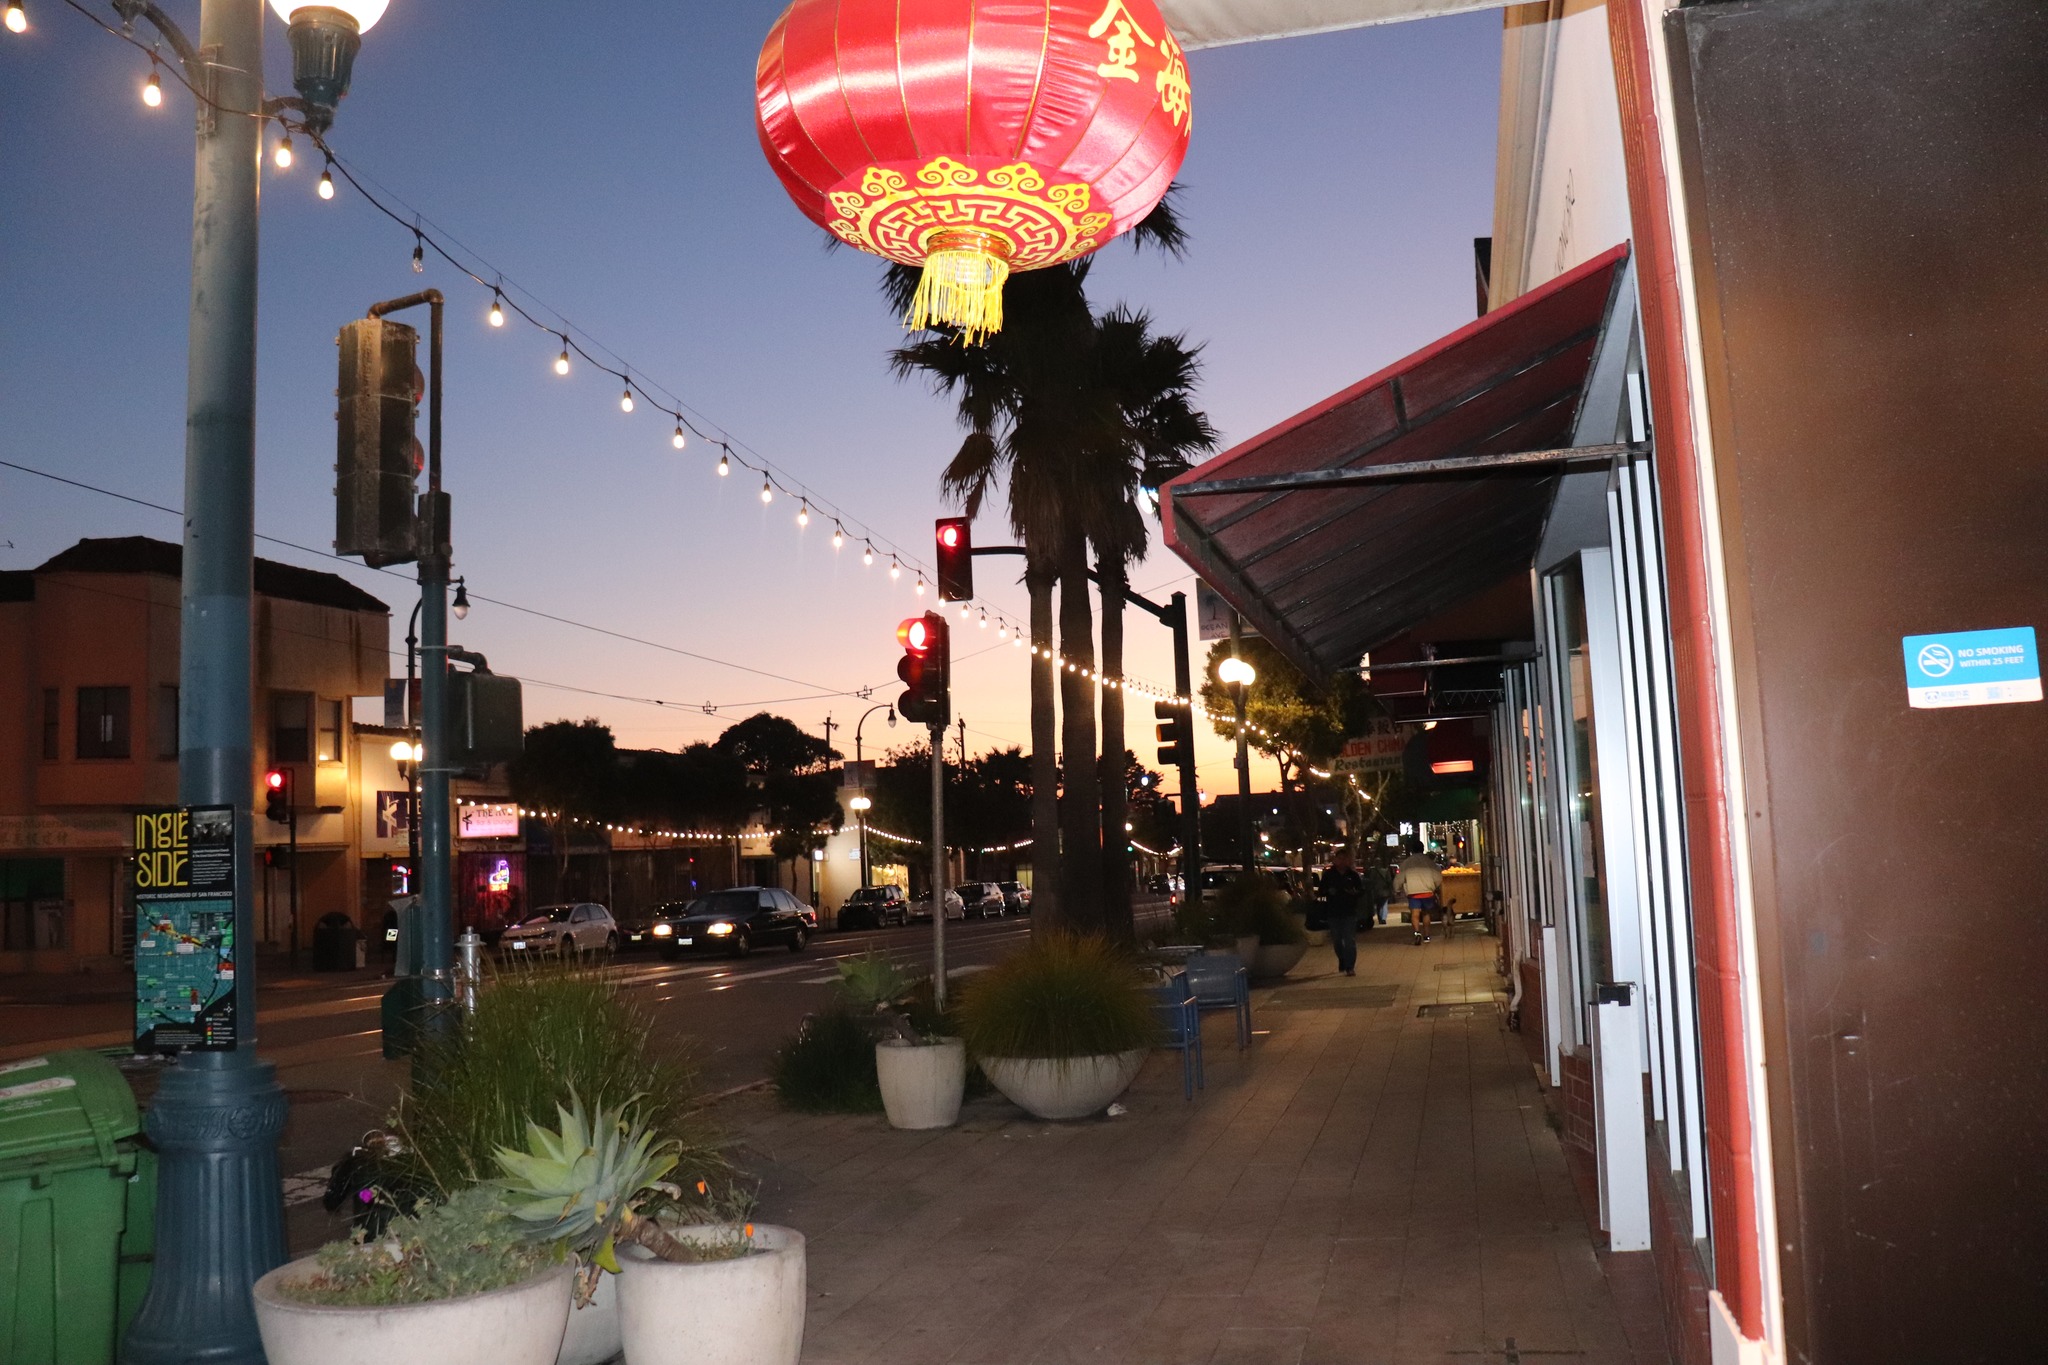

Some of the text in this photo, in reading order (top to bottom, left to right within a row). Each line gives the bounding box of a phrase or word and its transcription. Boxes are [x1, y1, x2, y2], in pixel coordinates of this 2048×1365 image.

[1201, 622, 1228, 631] OCEAN
[1958, 645, 2024, 658] NO SMOKING
[1960, 656, 2024, 668] WITHIN 25 FEET
[1335, 757, 1401, 770] Restauran
[136, 850, 188, 887] SIDE
